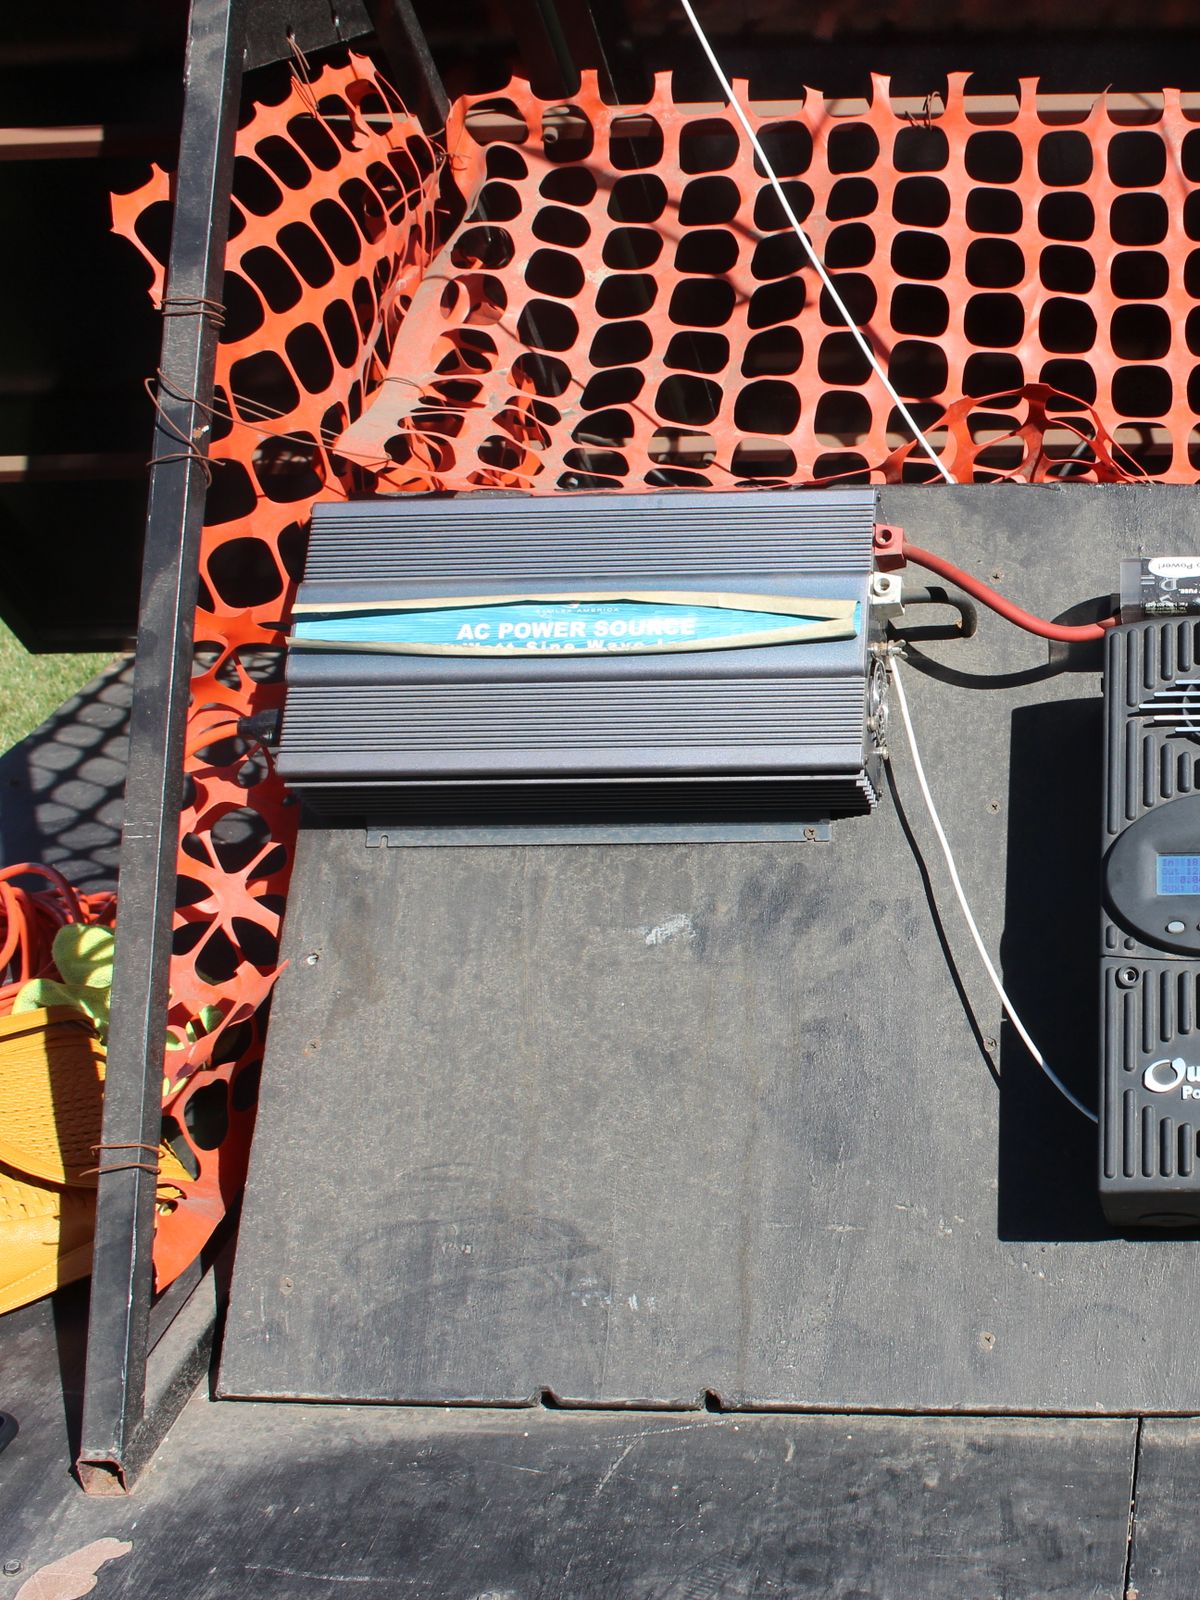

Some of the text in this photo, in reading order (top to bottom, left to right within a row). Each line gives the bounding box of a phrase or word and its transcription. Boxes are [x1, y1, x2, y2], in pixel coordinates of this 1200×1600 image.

[456, 617, 698, 640] AC POWER SOURCE
